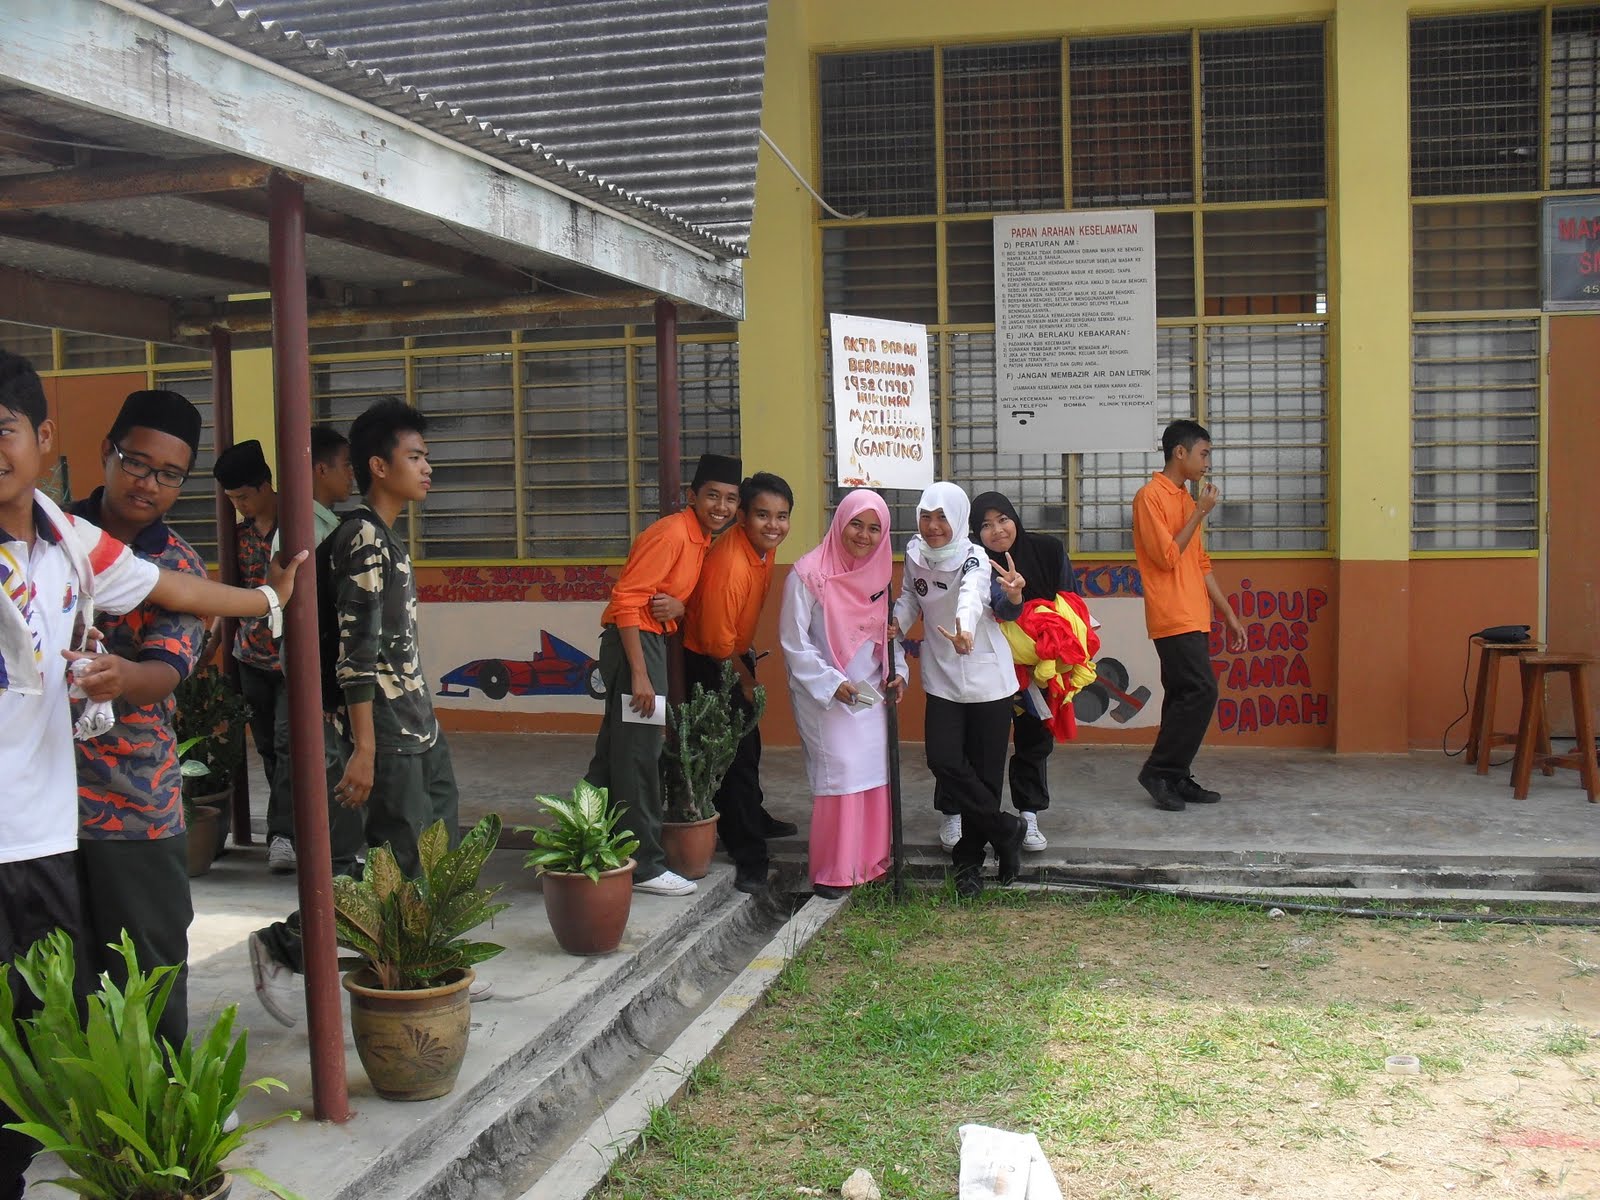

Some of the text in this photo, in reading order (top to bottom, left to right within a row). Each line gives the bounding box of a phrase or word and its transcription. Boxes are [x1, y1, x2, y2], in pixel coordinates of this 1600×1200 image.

[1011, 224, 1138, 238] PAPAN ARAHAN KESELAMATAN
[1016, 240, 1060, 248] PERATURAN
[1079, 329, 1130, 337] KEBAKARAN:
[843, 335, 918, 357] AKTA DADAH
[848, 358, 915, 377] BERBAHAYA
[857, 392, 911, 407] HUKUMAN
[854, 438, 923, 462] (GANTUNG)
[1218, 694, 1328, 732] DADAH
